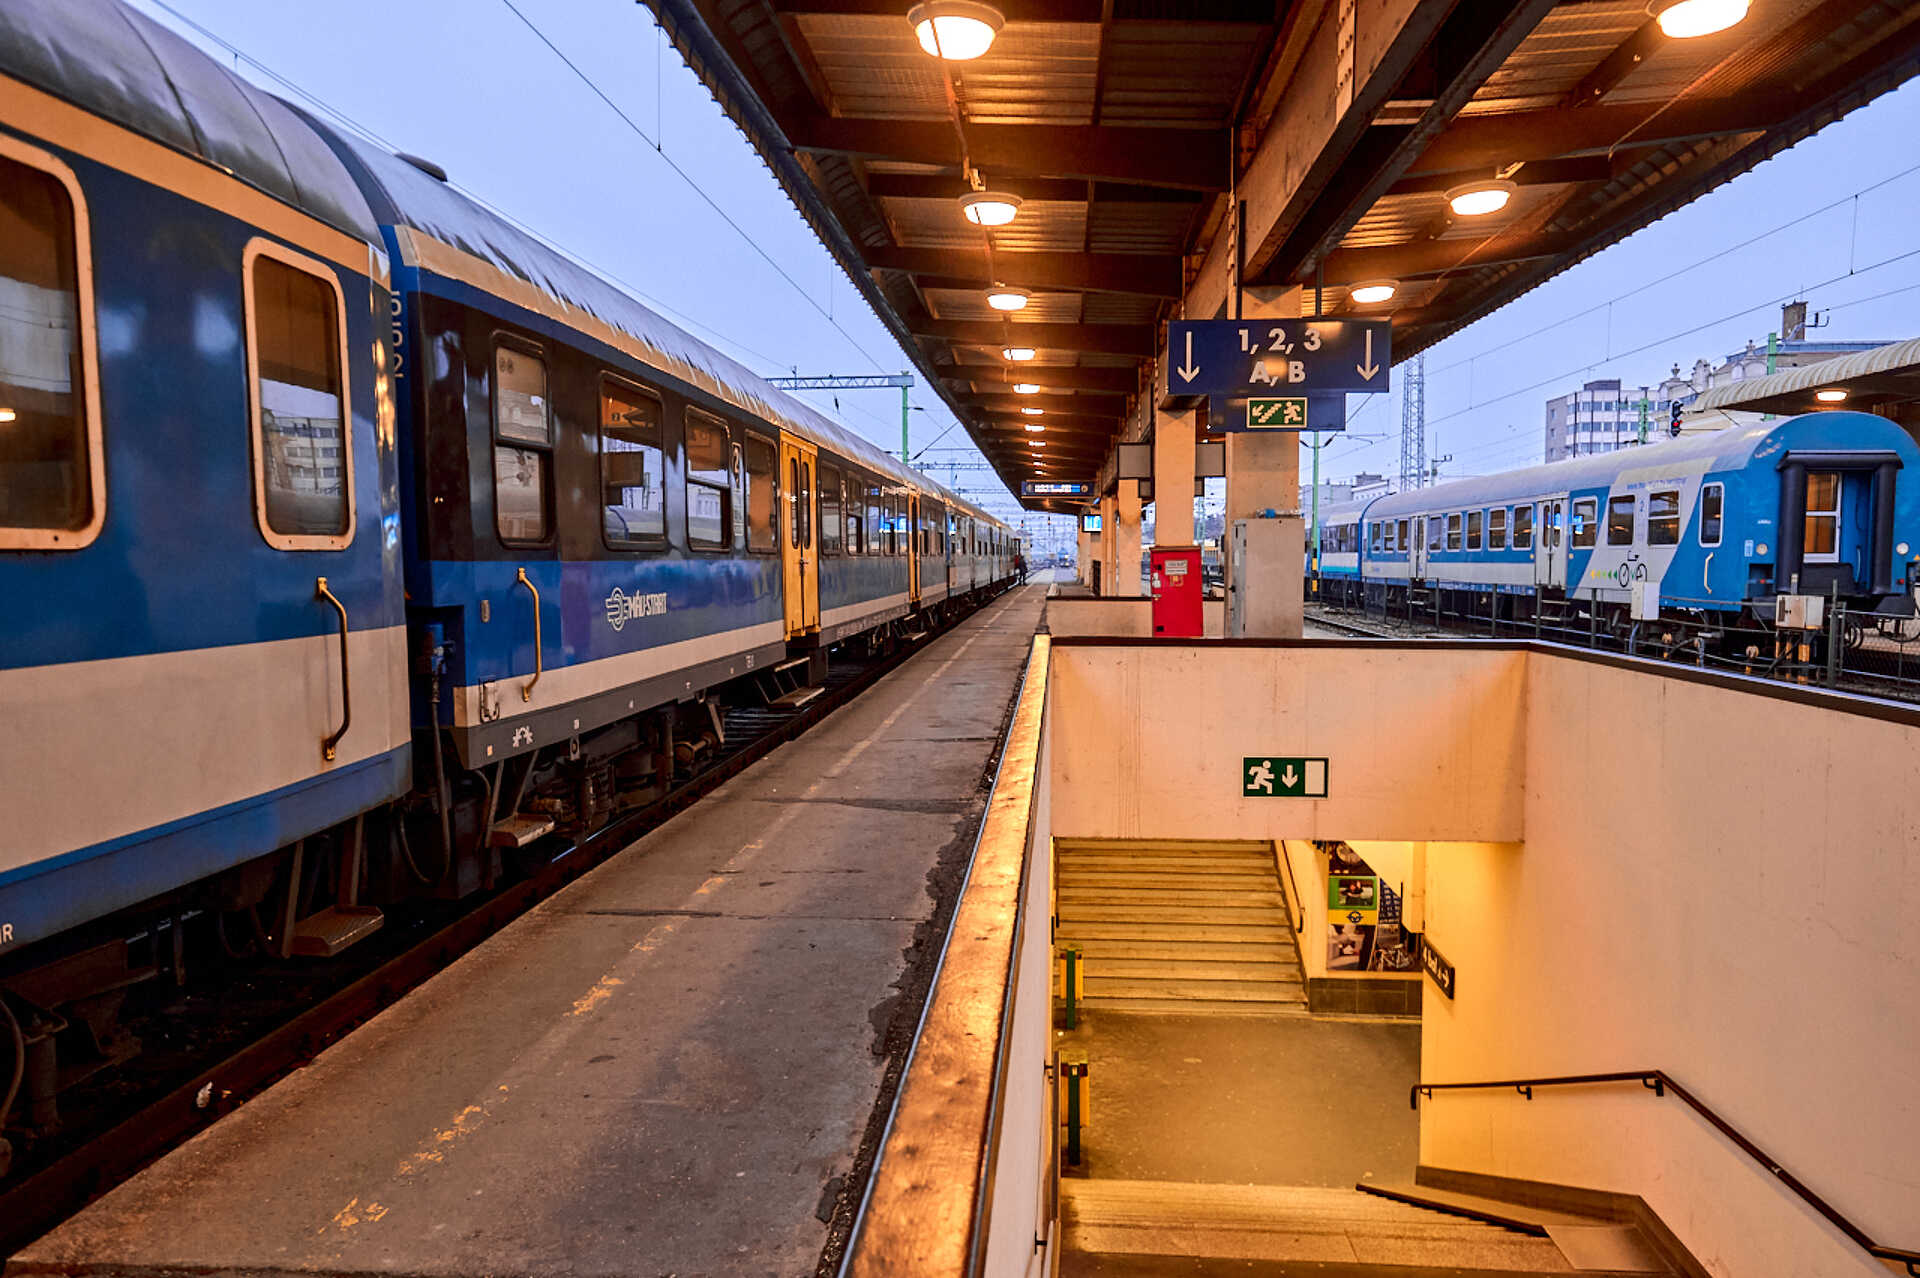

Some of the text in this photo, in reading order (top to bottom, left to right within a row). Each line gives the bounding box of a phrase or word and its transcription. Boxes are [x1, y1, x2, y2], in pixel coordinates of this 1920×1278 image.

[1238, 327, 1321, 355] 1, 2, 3
[1248, 360, 1306, 387] A, B
